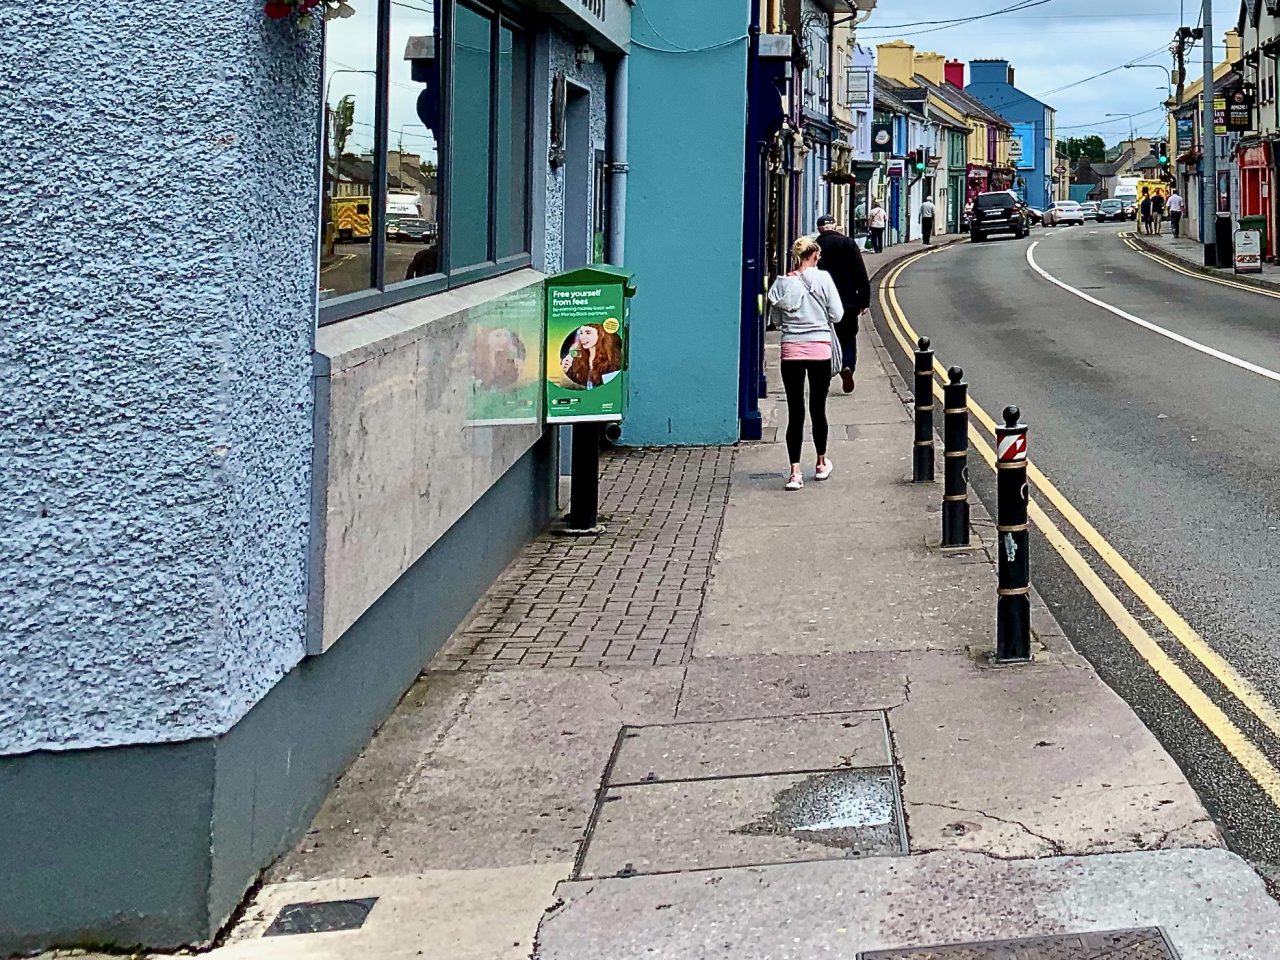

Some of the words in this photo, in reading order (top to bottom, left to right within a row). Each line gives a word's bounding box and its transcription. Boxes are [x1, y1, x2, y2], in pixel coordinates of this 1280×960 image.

[553, 290, 570, 298] Free
[570, 289, 602, 299] yourself
[552, 298, 572, 306] from
[572, 298, 589, 306] fees
